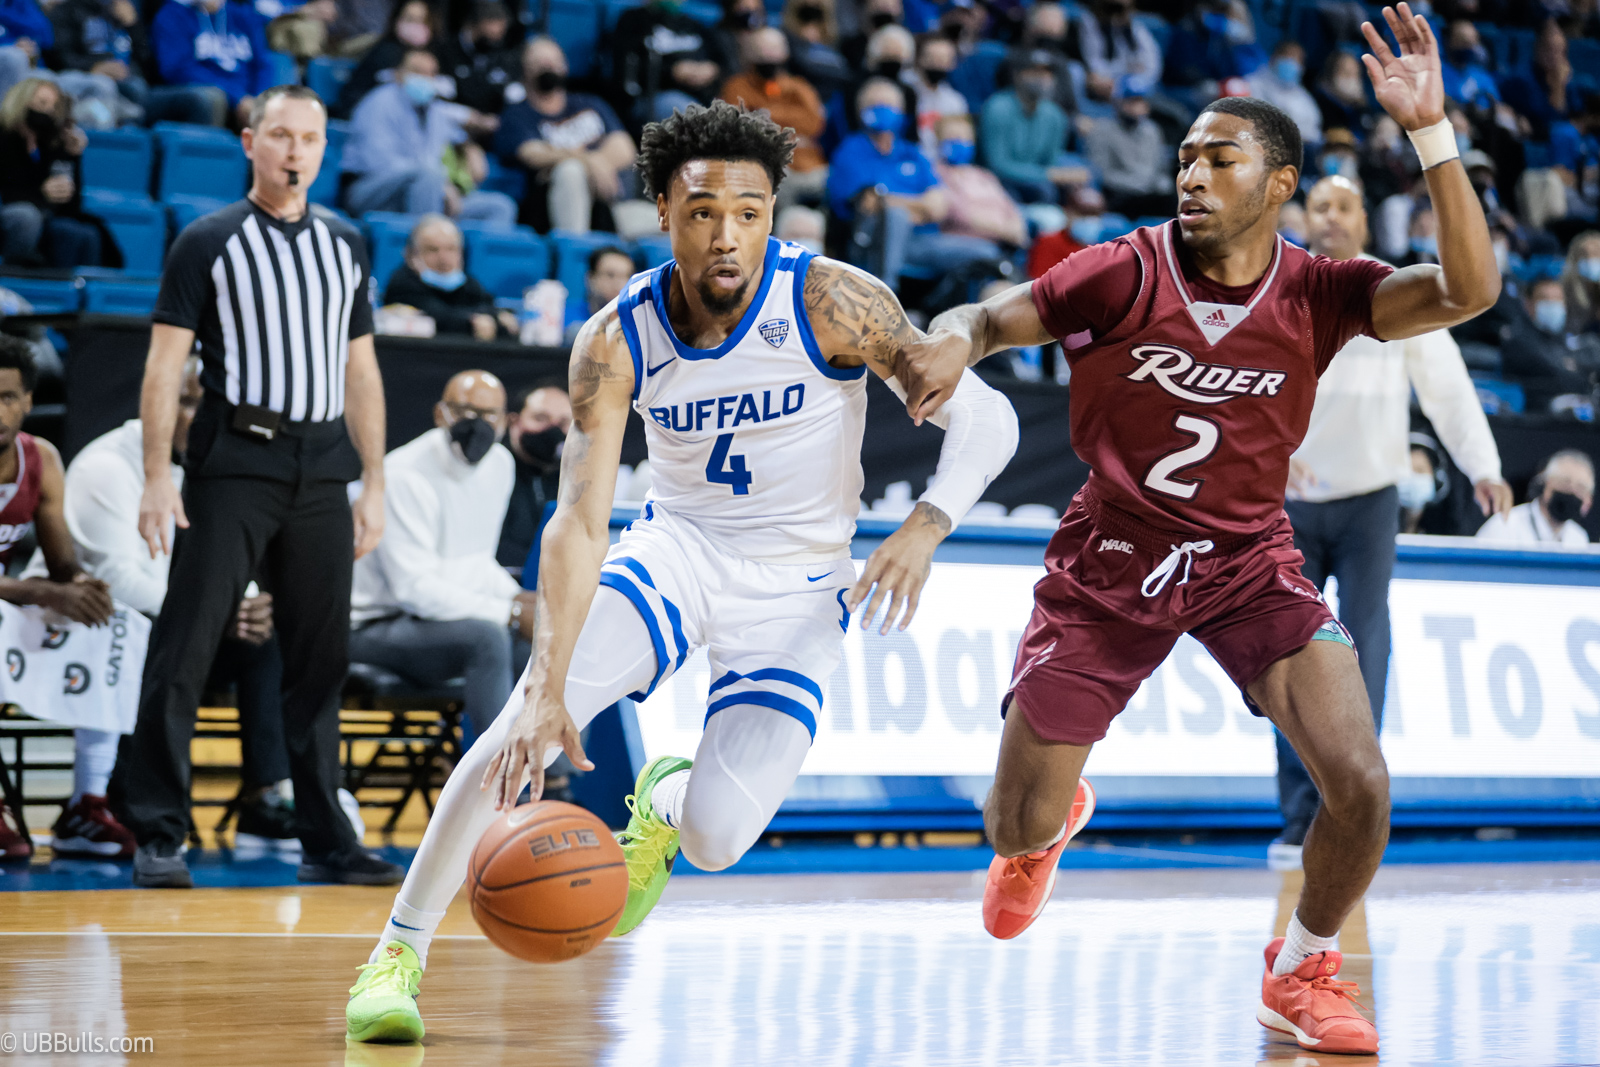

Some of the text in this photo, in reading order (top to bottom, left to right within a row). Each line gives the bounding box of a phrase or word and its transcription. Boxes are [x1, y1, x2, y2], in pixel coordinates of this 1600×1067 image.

[761, 326, 788, 339] MAC
[1202, 319, 1230, 328] adidas
[1127, 344, 1288, 403] RIDER
[648, 382, 805, 432] BUFFALO
[705, 433, 753, 496] 4
[1143, 412, 1221, 501] 2
[1097, 538, 1135, 555] MAAC
[1421, 612, 1545, 740] To
